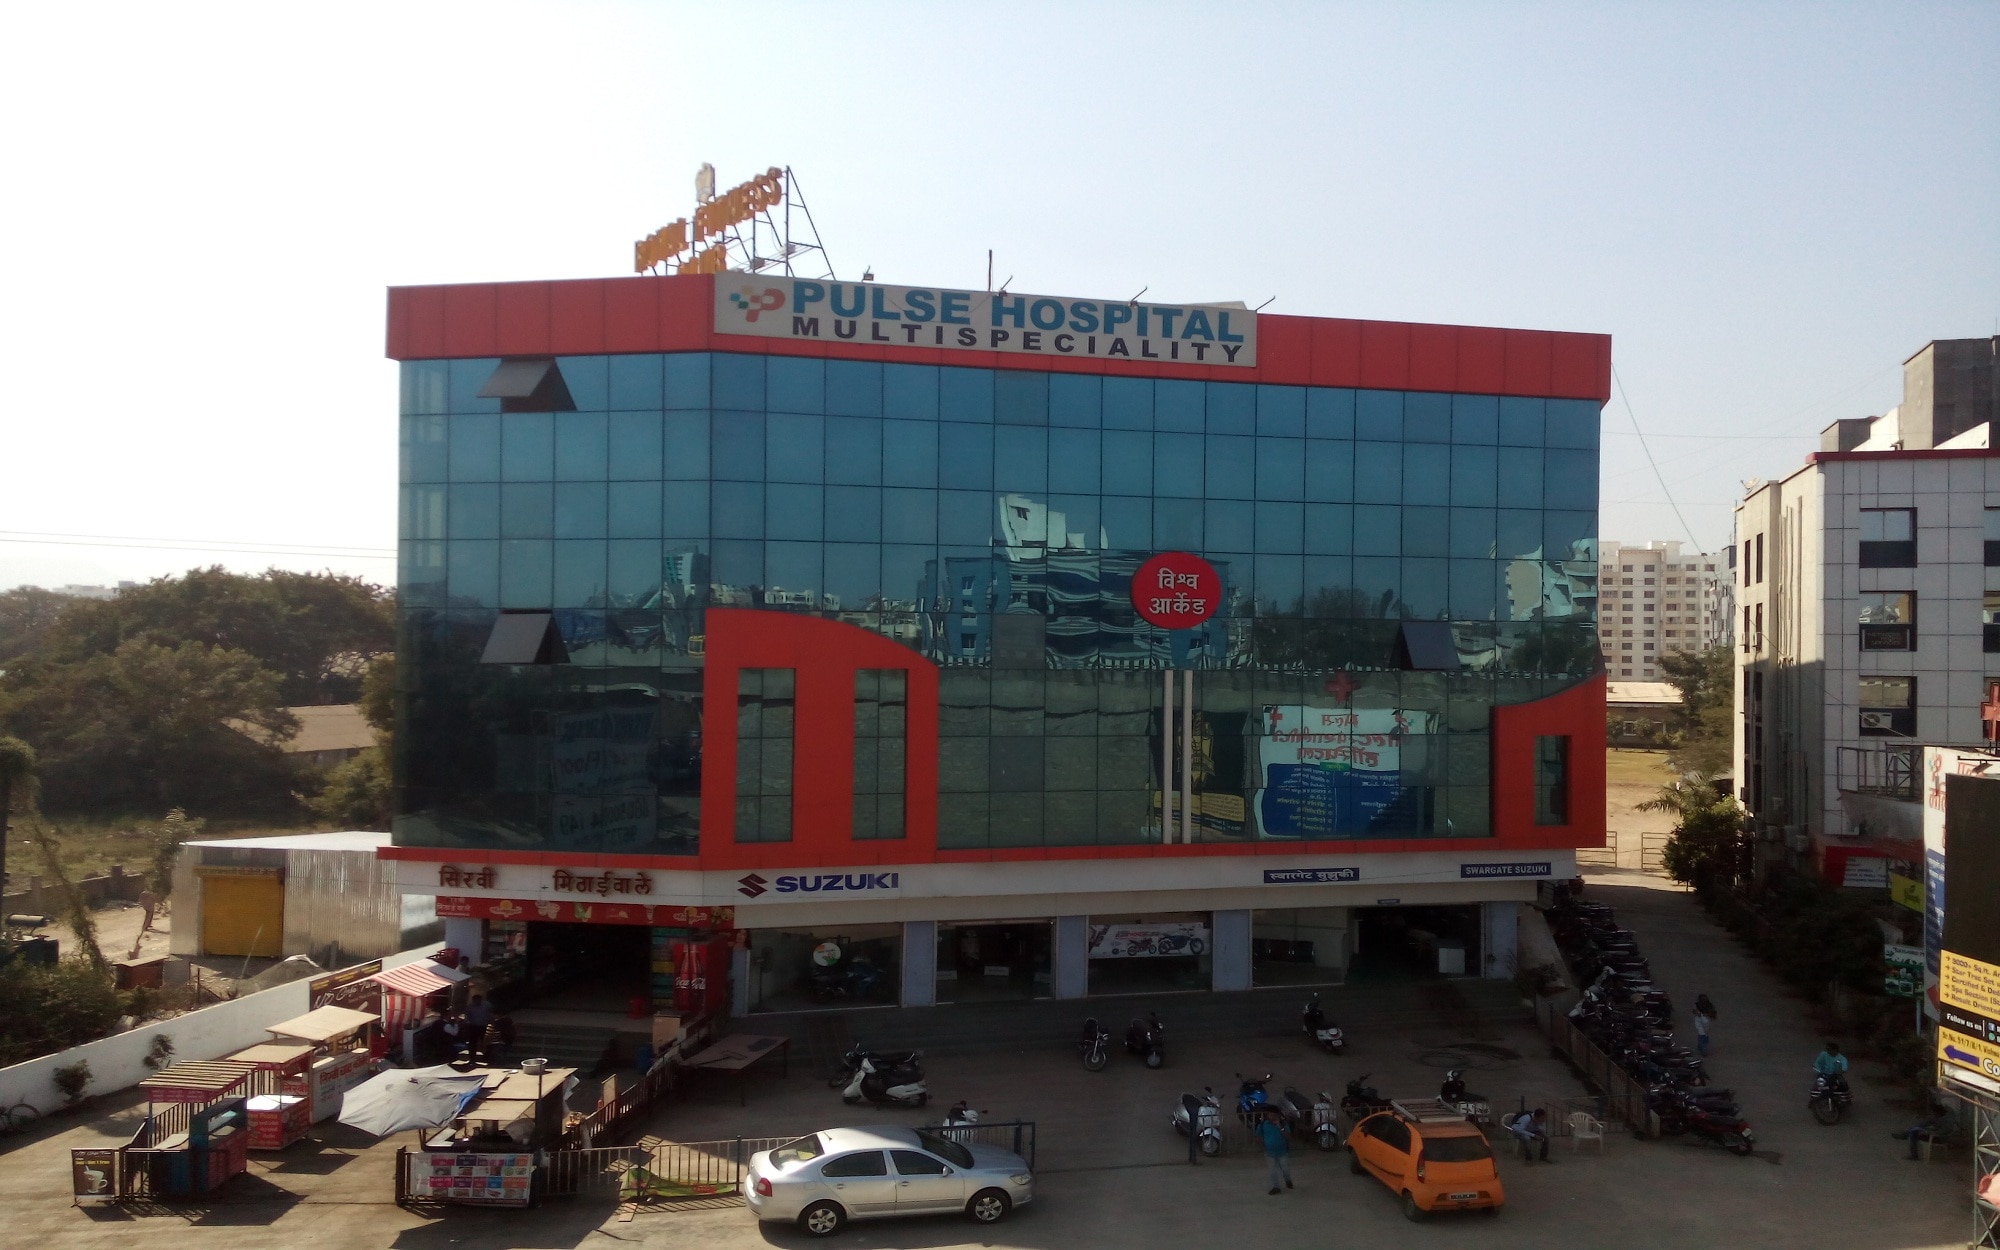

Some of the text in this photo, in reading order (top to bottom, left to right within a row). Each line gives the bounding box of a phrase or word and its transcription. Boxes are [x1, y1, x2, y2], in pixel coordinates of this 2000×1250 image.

[793, 281, 1244, 343] PULSE HOSPITAL
[792, 316, 1242, 363] MULTISPECIALITY
[1157, 567, 1199, 590] विश्व
[1149, 592, 1206, 615] आर्केड
[439, 865, 497, 889] सिरवी
[1466, 865, 1547, 875] SWARGATE SUZUKI
[775, 873, 899, 893] SUZUKI
[1946, 1013, 1965, 1025] Follow
[1966, 1020, 1974, 1029] us
